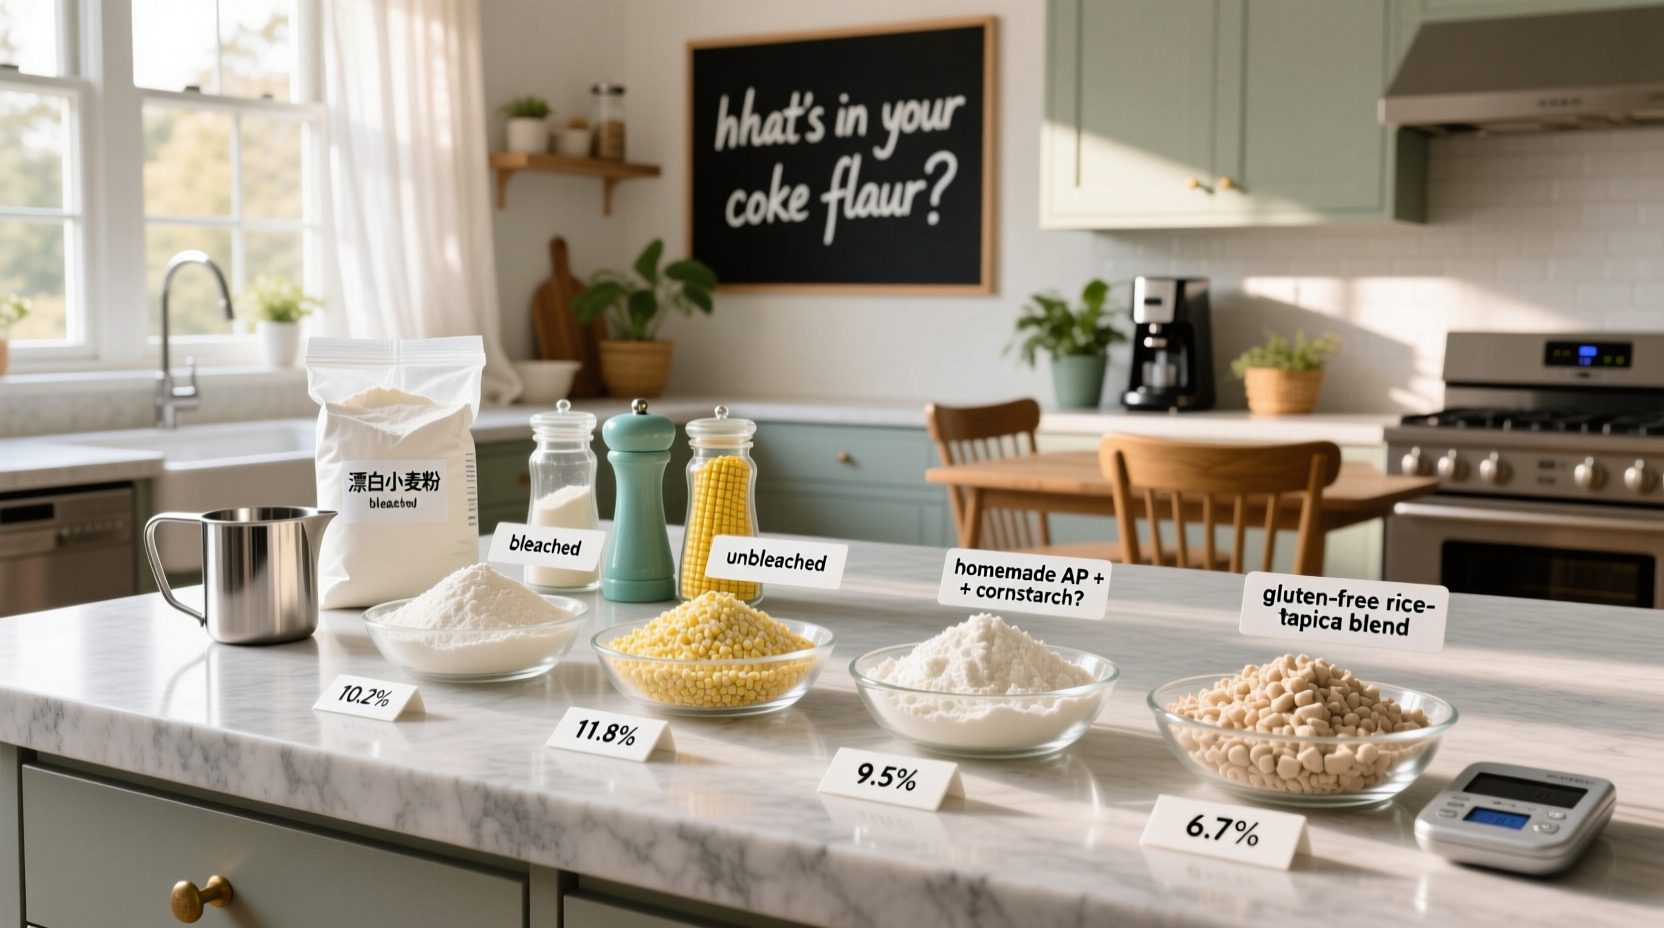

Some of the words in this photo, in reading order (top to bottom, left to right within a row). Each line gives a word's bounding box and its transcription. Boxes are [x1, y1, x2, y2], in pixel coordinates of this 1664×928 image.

[835, 93, 868, 137] in
[872, 95, 966, 160] your
[725, 162, 810, 228] coke
[820, 150, 958, 246] flaur?
[348, 470, 441, 493] 漂白小麦粉
[509, 534, 582, 557] bleached
[726, 548, 828, 572] unbleached
[954, 558, 1057, 583] homemade
[1060, 566, 1089, 585] AP
[1093, 572, 1105, 585] +
[959, 582, 972, 596] +
[976, 583, 1085, 607] cornstarch?
[1262, 584, 1380, 610] gluten-free
[1386, 593, 1436, 613] rice-
[1278, 608, 1343, 632] tapica
[1349, 613, 1410, 636] blend
[338, 685, 393, 707] 10.2%
[576, 719, 639, 746] 11.8%
[857, 762, 918, 792] 9.5%
[1186, 814, 1259, 847] 6.7%
